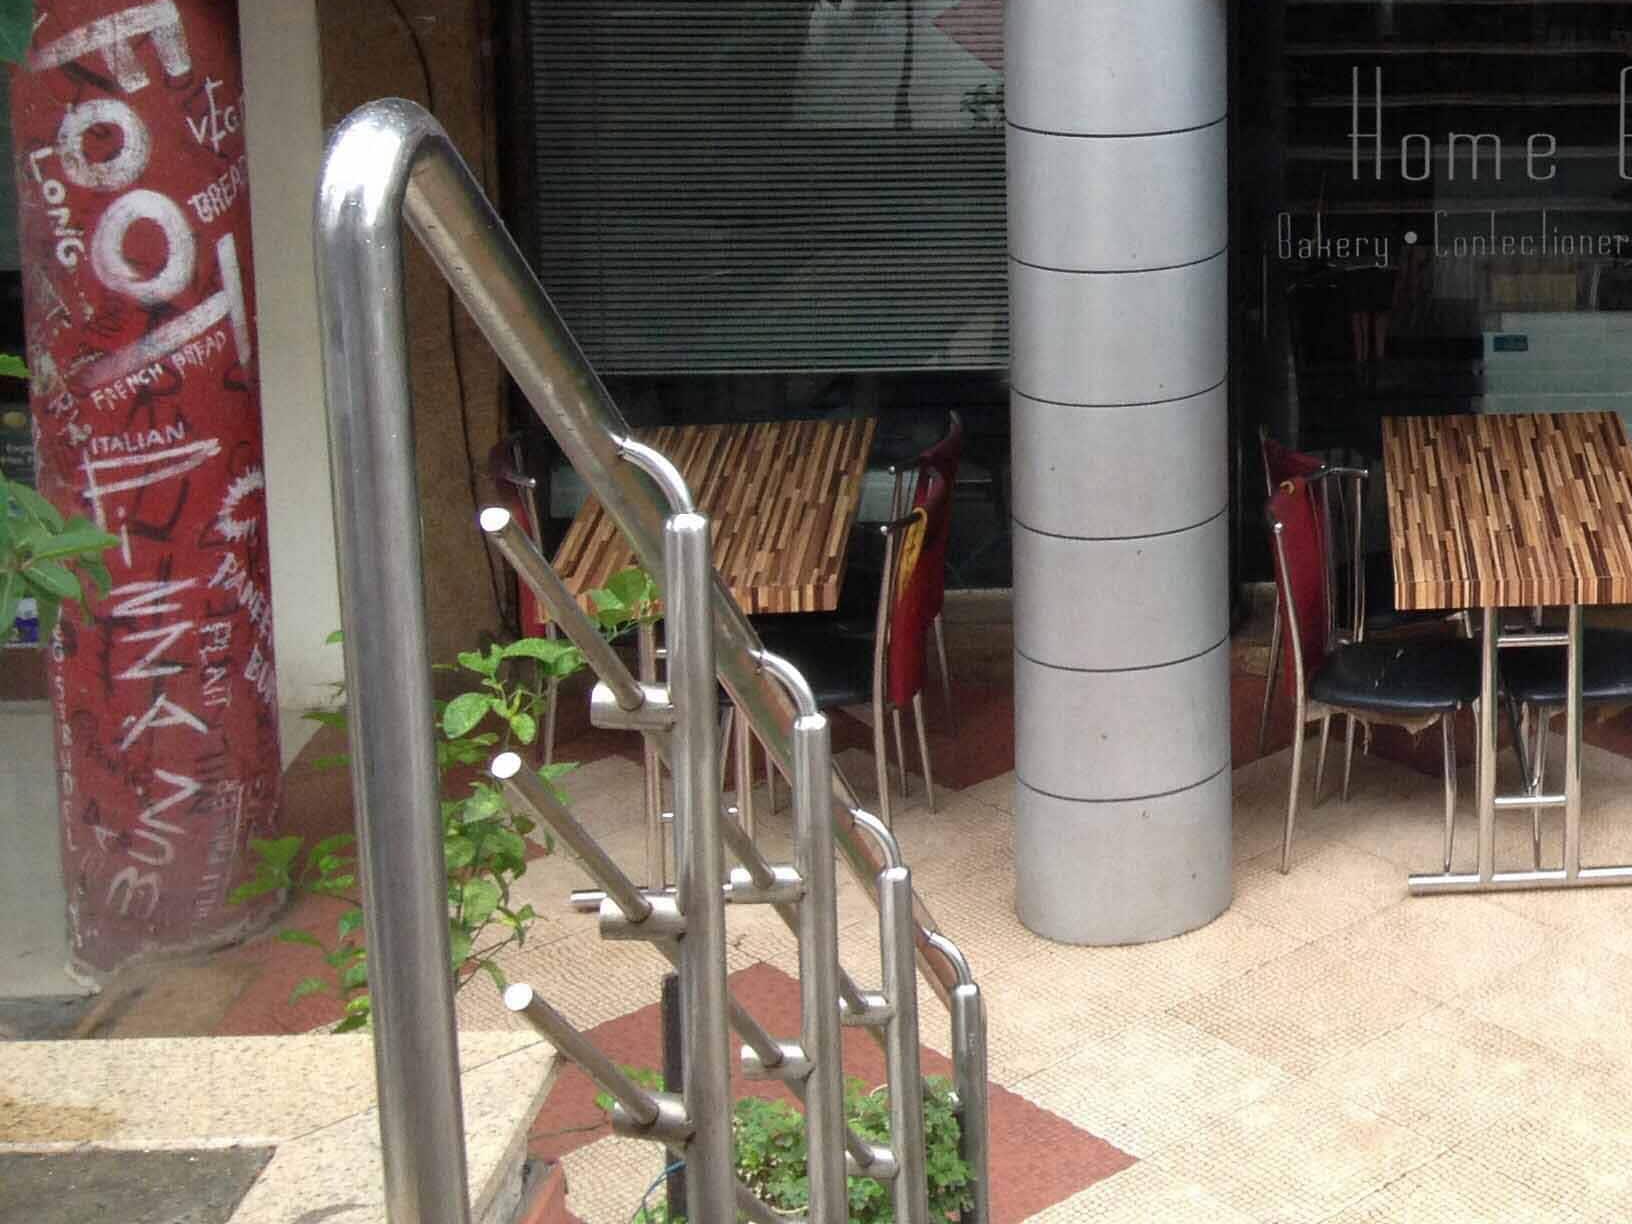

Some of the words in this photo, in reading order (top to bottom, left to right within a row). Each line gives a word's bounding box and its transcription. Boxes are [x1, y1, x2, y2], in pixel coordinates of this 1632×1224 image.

[1347, 65, 1557, 181] Home
[1277, 211, 1389, 268] Bakery
[91, 421, 187, 455] ITALIAN
